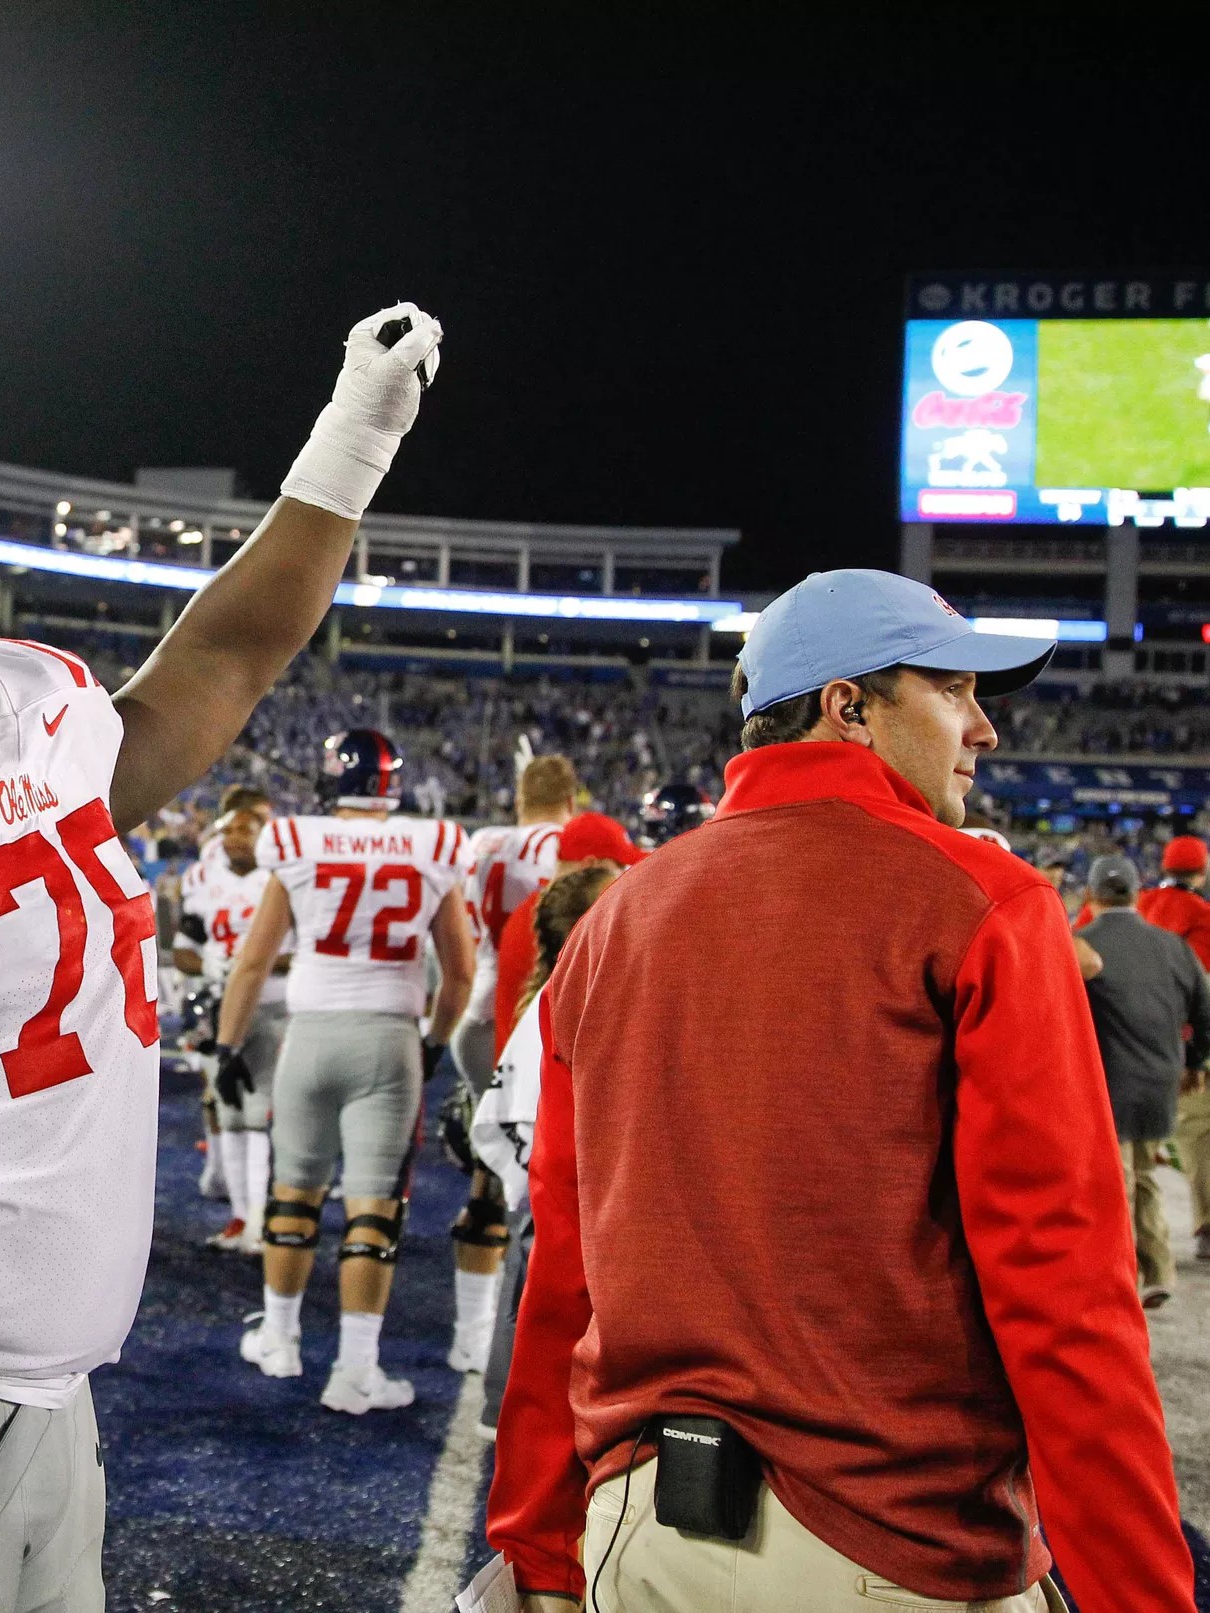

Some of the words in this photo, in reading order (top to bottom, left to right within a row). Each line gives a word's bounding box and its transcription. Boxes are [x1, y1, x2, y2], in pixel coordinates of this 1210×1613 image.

[960, 282, 1152, 311] KROGER
[19, 773, 59, 815] Miss
[323, 833, 413, 855] NEWMAN
[315, 863, 423, 961] 72
[663, 1428, 721, 1447] COMTEK
